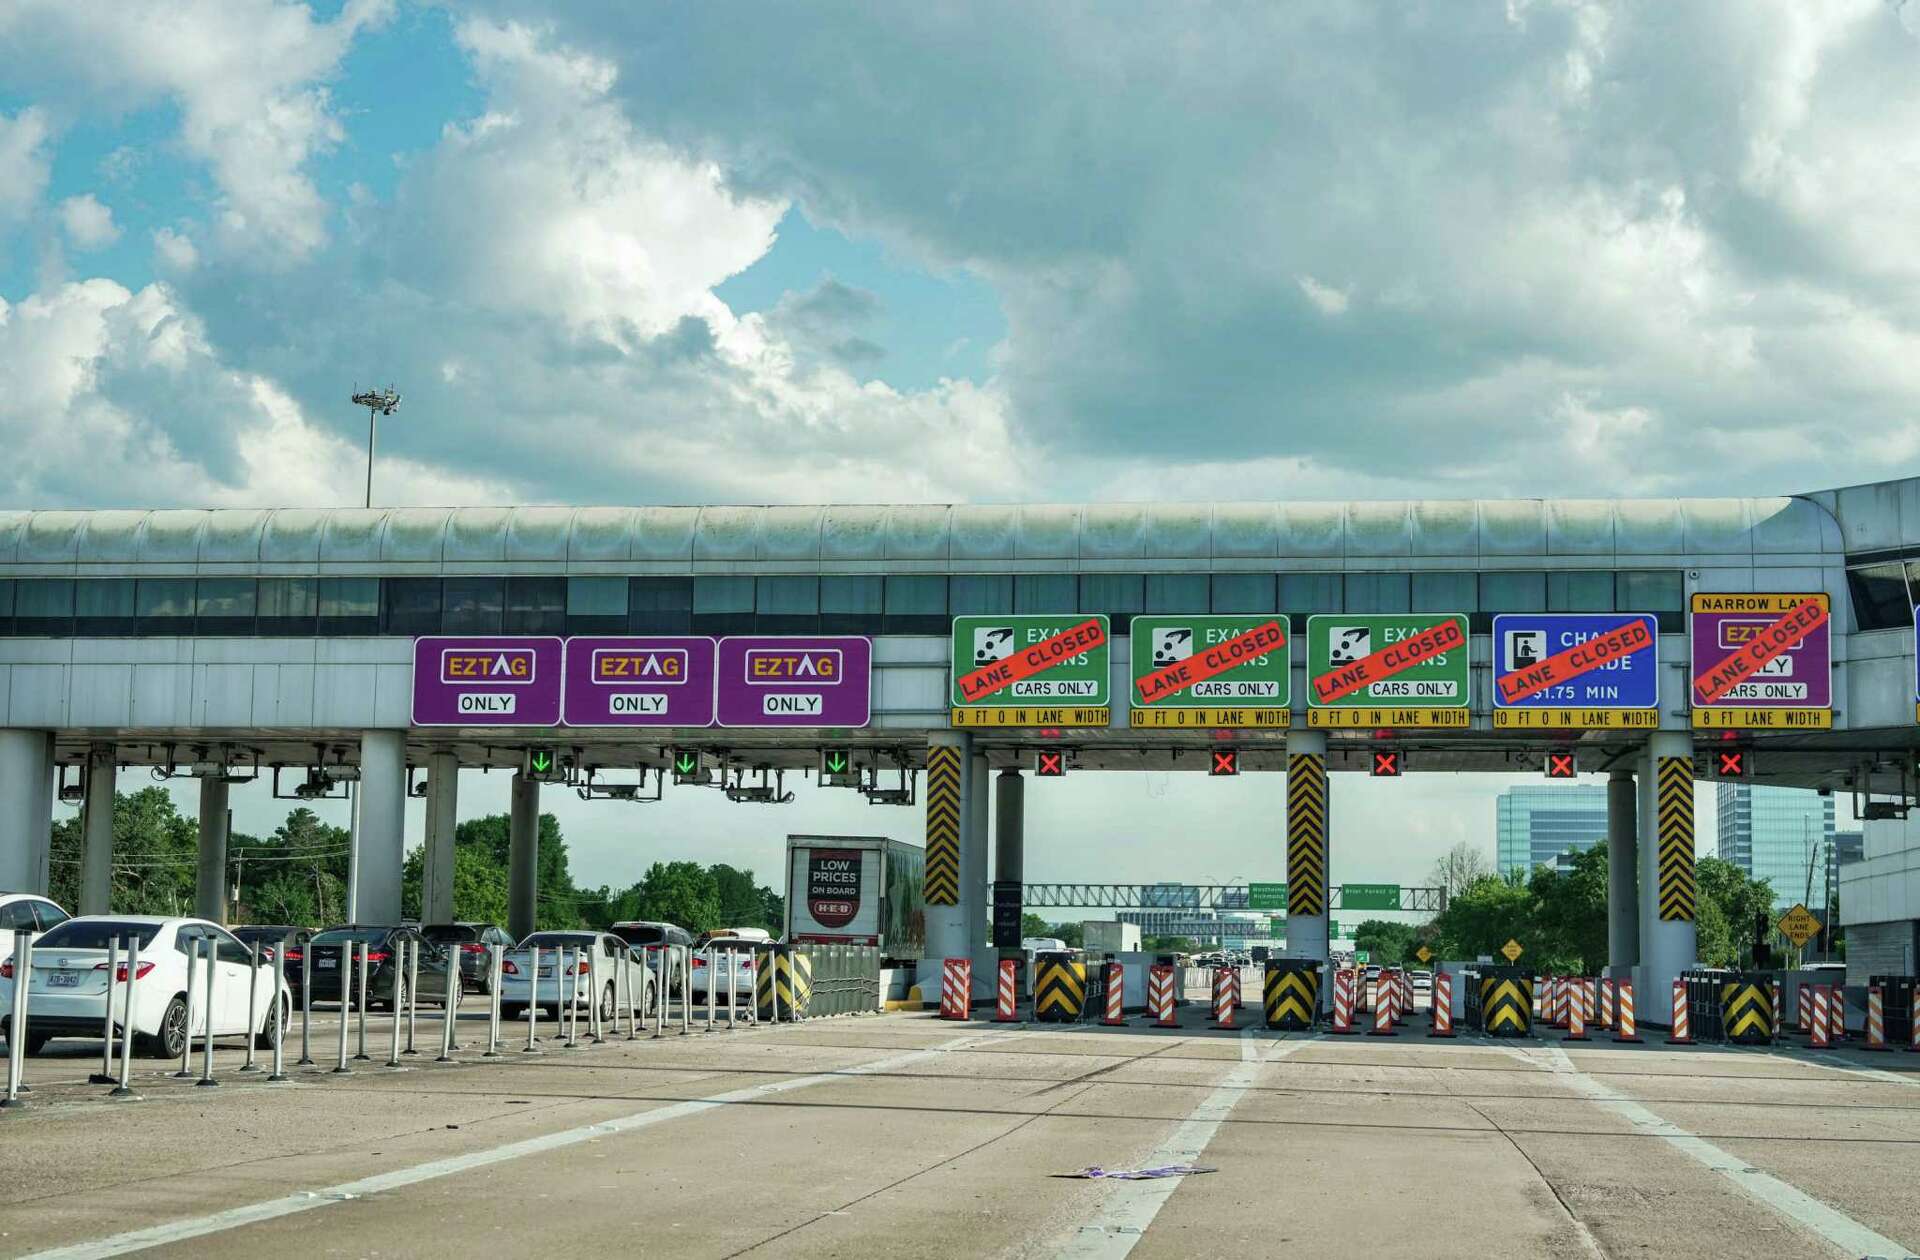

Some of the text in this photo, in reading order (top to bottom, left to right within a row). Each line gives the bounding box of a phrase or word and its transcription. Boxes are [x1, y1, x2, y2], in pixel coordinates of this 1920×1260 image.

[1702, 598, 1818, 609] NARROW LA
[1027, 628, 1072, 643] EXA
[1207, 628, 1253, 643] EXA
[1384, 628, 1431, 643] EXA
[1699, 605, 1820, 698] LANE CLOSED
[962, 626, 1101, 696] LANE CLOSED
[1140, 628, 1280, 698] LANE CLOSED
[1317, 626, 1459, 696] LANE CLOSED
[1502, 627, 1646, 696] LANE CLOSED
[1015, 682, 1051, 695] CARS
[1058, 682, 1093, 695] ONLY
[1195, 683, 1231, 696] CARS
[1238, 683, 1274, 696] ONLY
[1372, 683, 1409, 696] CARS
[1416, 683, 1453, 696] ONLY
[1586, 686, 1618, 699] MIN
[1722, 685, 1802, 697] ARS ONLY
[461, 696, 512, 711] ONLY
[613, 696, 664, 711] ONLY
[767, 697, 818, 712] ONLY
[958, 710, 1108, 724] 8 FT 0 IN LANE WIDTH
[1133, 711, 1288, 724] 10 FT 0 IN LANE WIDTH
[1312, 711, 1465, 724] 8 FT 0 IN LANE WIDTH
[1496, 712, 1657, 725] 10 FT 0 IN LANE WIDTH
[1704, 711, 1821, 725] 8 FT LANE WIDTH
[820, 860, 850, 870] LOW
[813, 872, 857, 883] PRICES
[826, 887, 856, 895] BOARD
